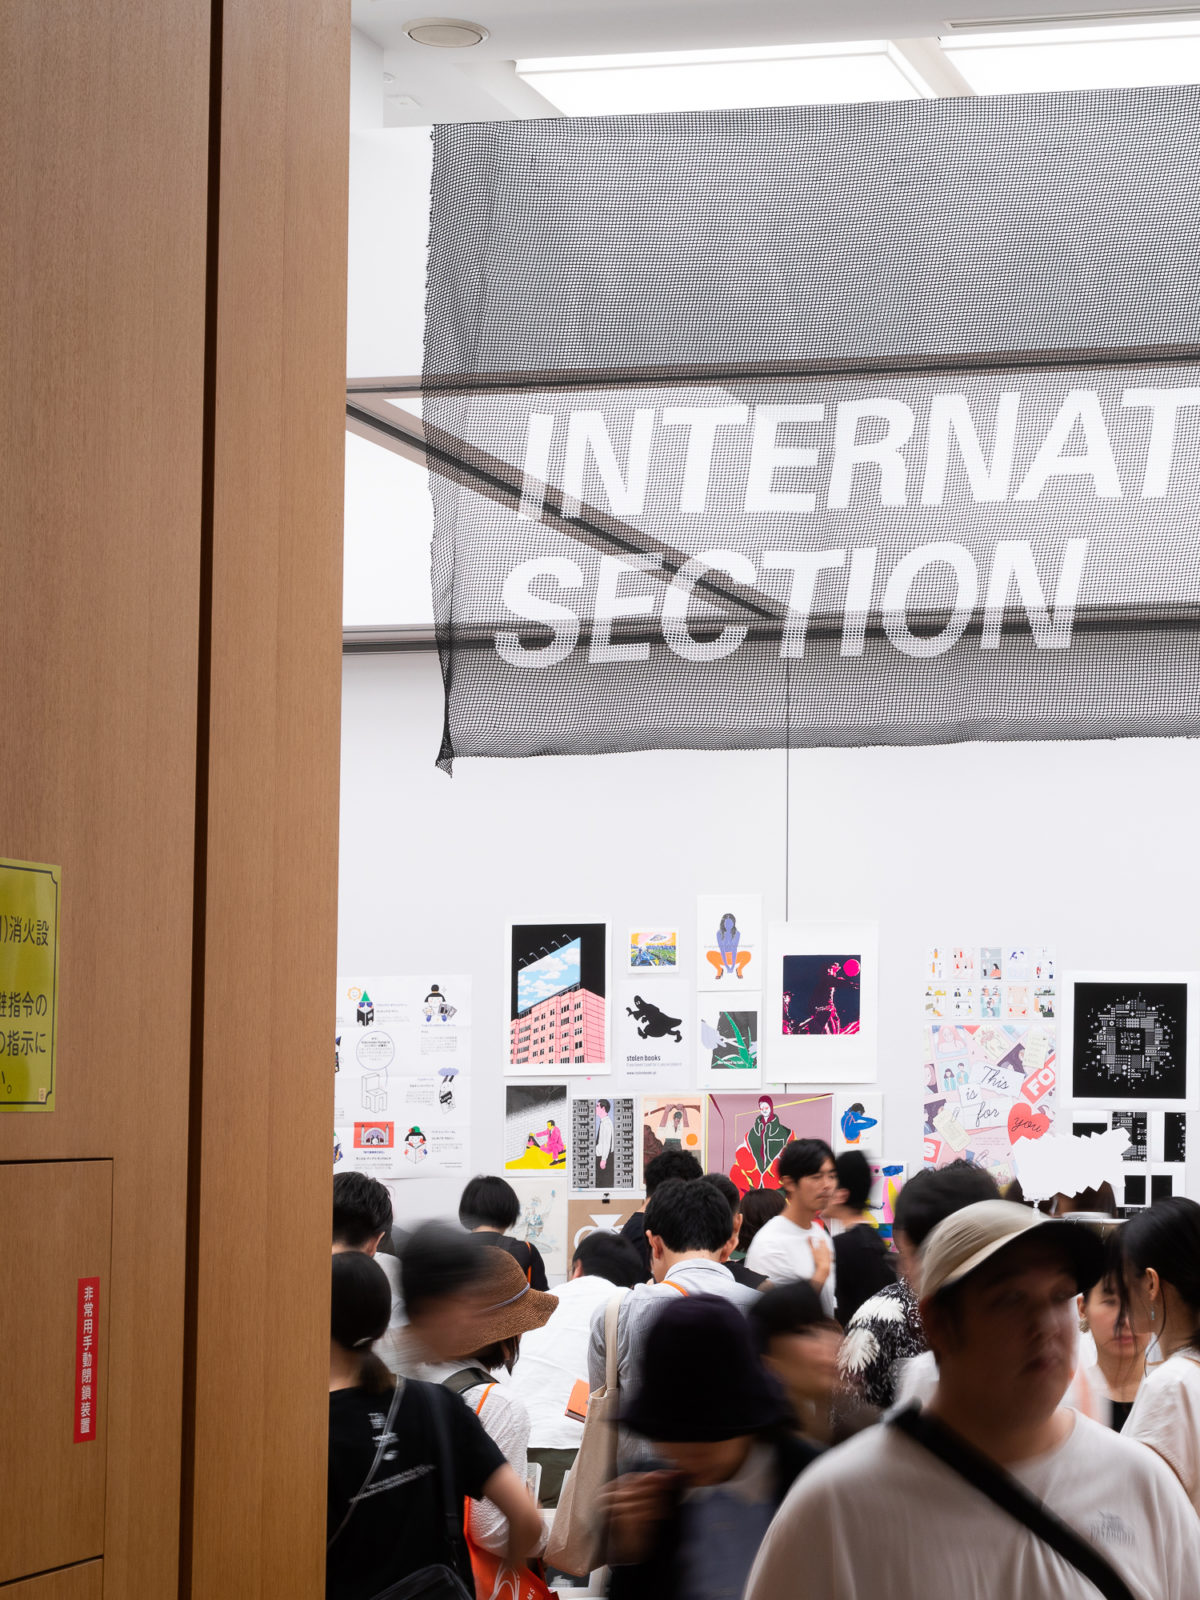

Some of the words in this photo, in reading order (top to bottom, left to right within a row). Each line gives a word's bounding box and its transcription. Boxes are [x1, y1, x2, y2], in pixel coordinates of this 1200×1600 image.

[494, 537, 1089, 669] SECTION
[0, 915, 49, 946] )消火設
[626, 1054, 643, 1062] stolen
[644, 1054, 661, 1062] books
[981, 1065, 1009, 1090] This
[965, 1087, 978, 1100] is
[975, 1100, 1000, 1127] for
[1011, 1117, 1042, 1132] you
[80, 1286, 94, 1435] 非常用手動閉鎖装置
